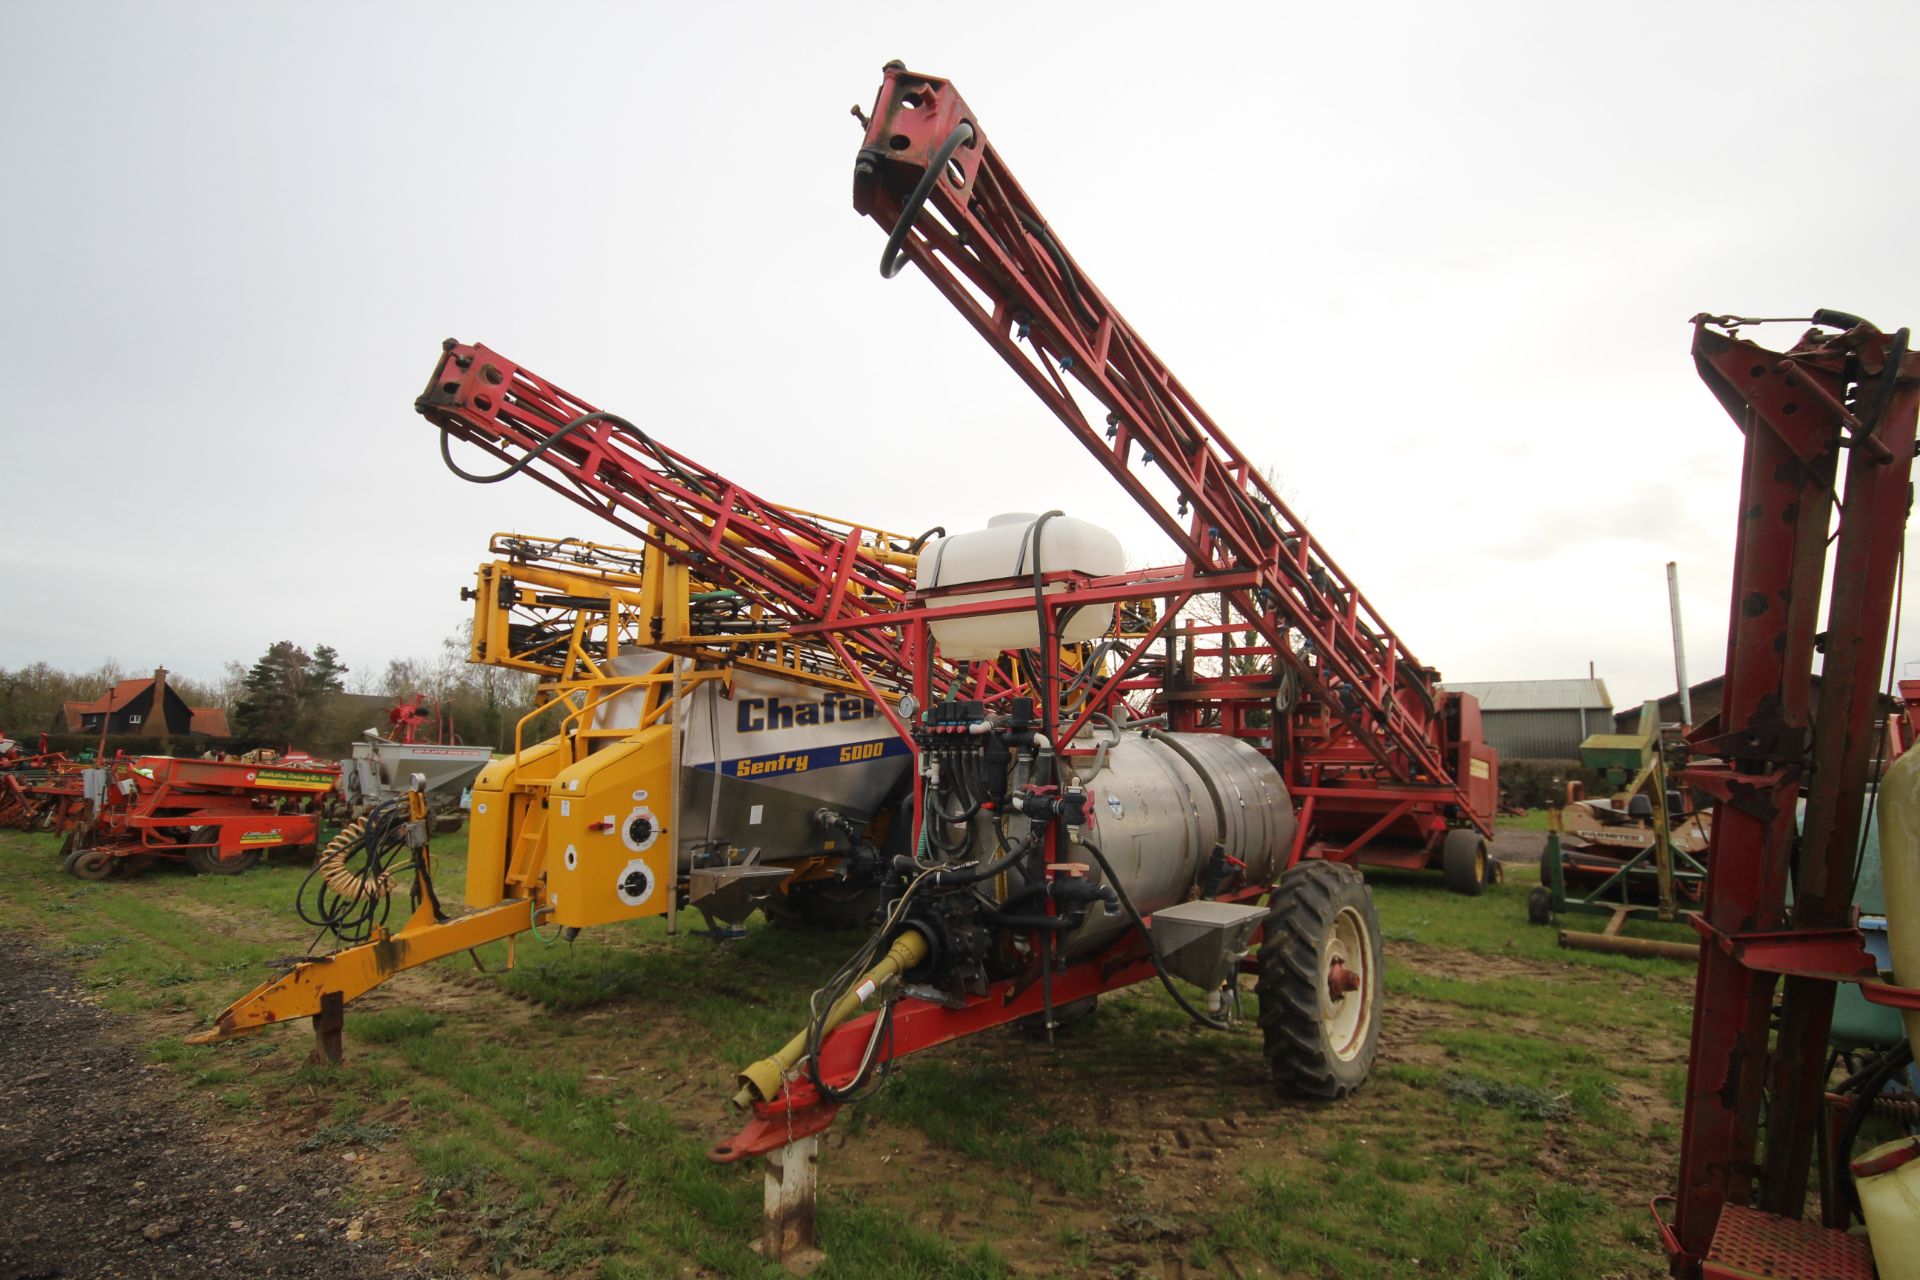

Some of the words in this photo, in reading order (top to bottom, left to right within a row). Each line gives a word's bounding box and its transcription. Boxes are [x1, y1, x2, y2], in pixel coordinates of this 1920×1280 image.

[737, 692, 875, 733] Chafer
[736, 754, 809, 777] Sentry
[839, 742, 884, 762] 5000
[1581, 831, 1640, 840] PARMITER
